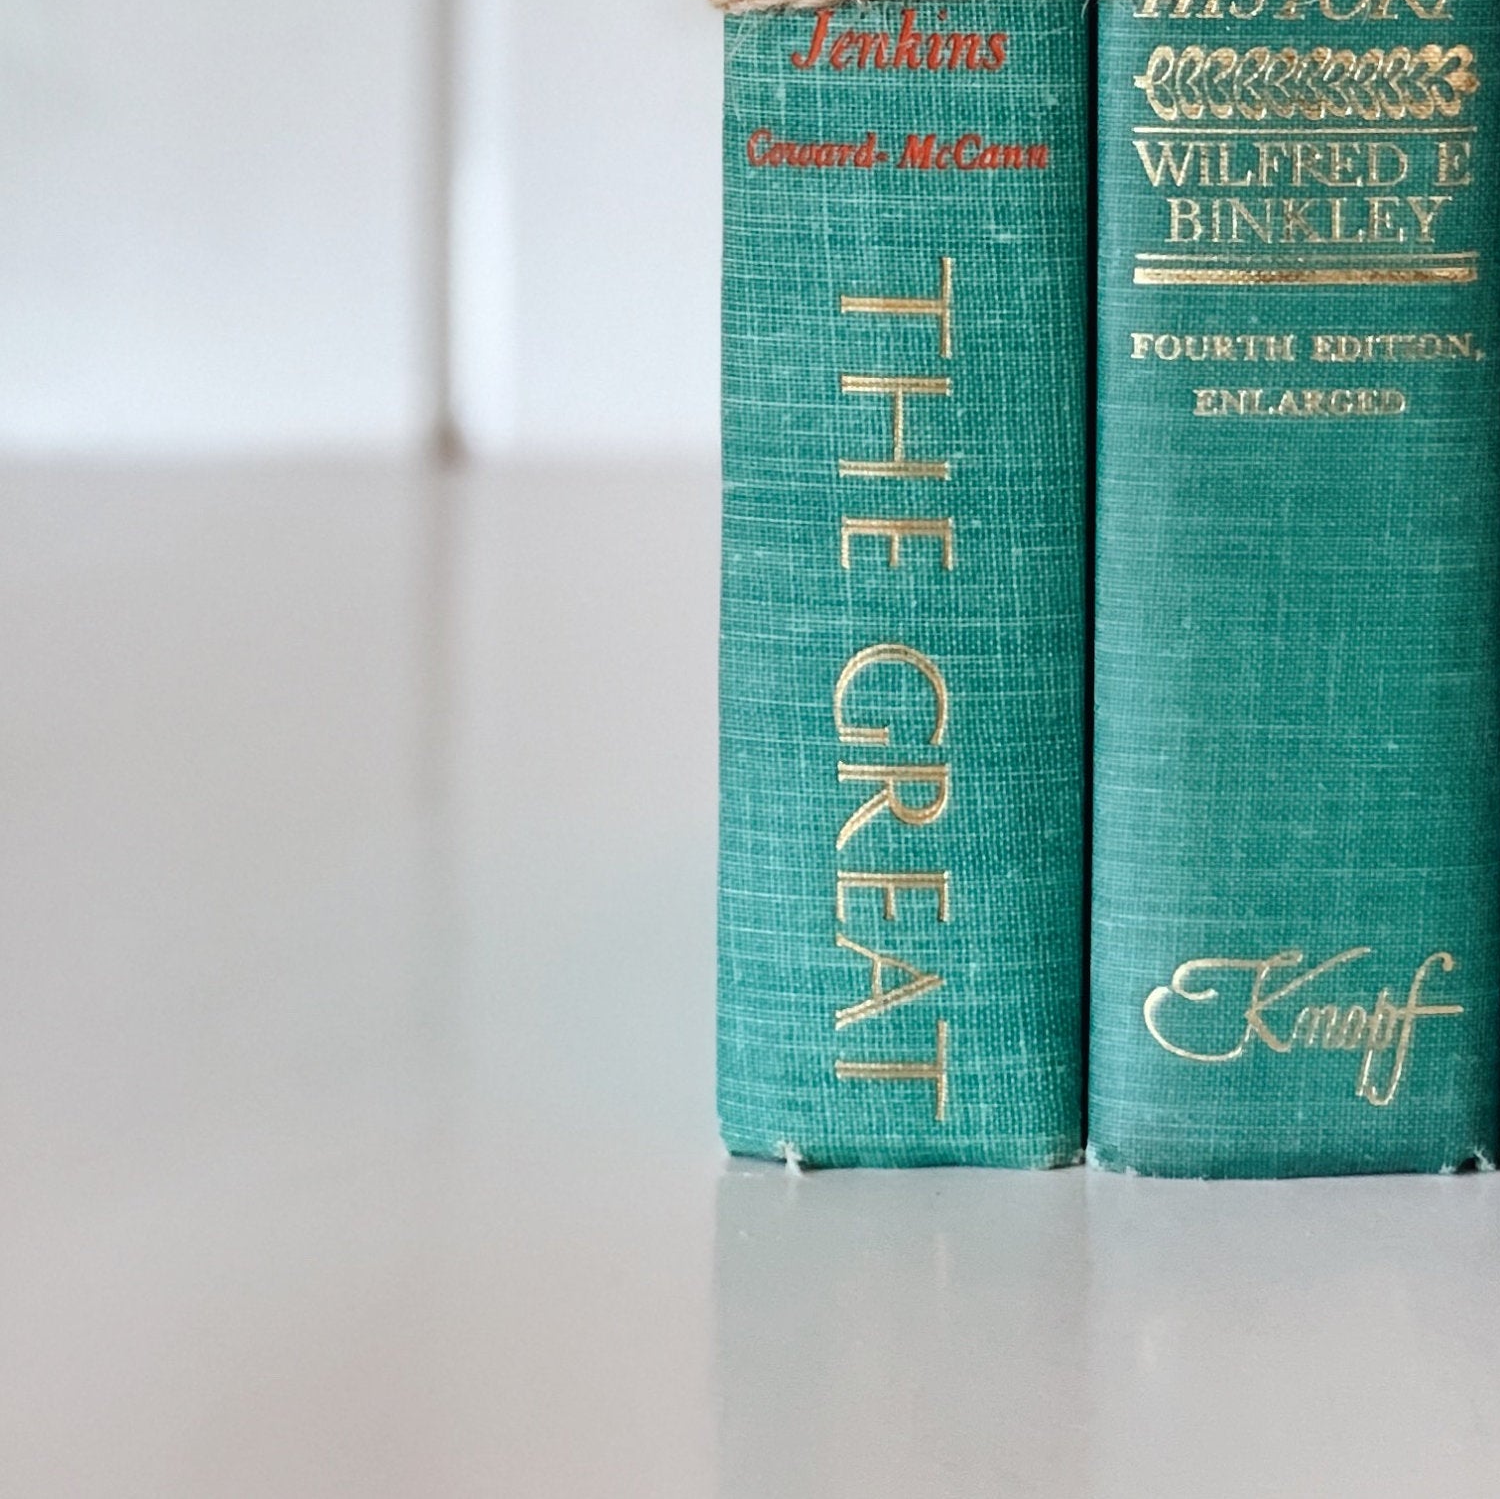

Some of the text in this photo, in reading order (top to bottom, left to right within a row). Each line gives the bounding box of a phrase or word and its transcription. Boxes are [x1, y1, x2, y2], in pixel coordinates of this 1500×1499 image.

[790, 8, 1009, 71] Jenkins
[1131, 139, 1409, 187] WILFRED
[1163, 195, 1454, 244] BINKLEY
[1130, 332, 1299, 362] FOURTH
[1192, 387, 1408, 418] ENLARGED
[833, 256, 955, 1121] THE GREAT
